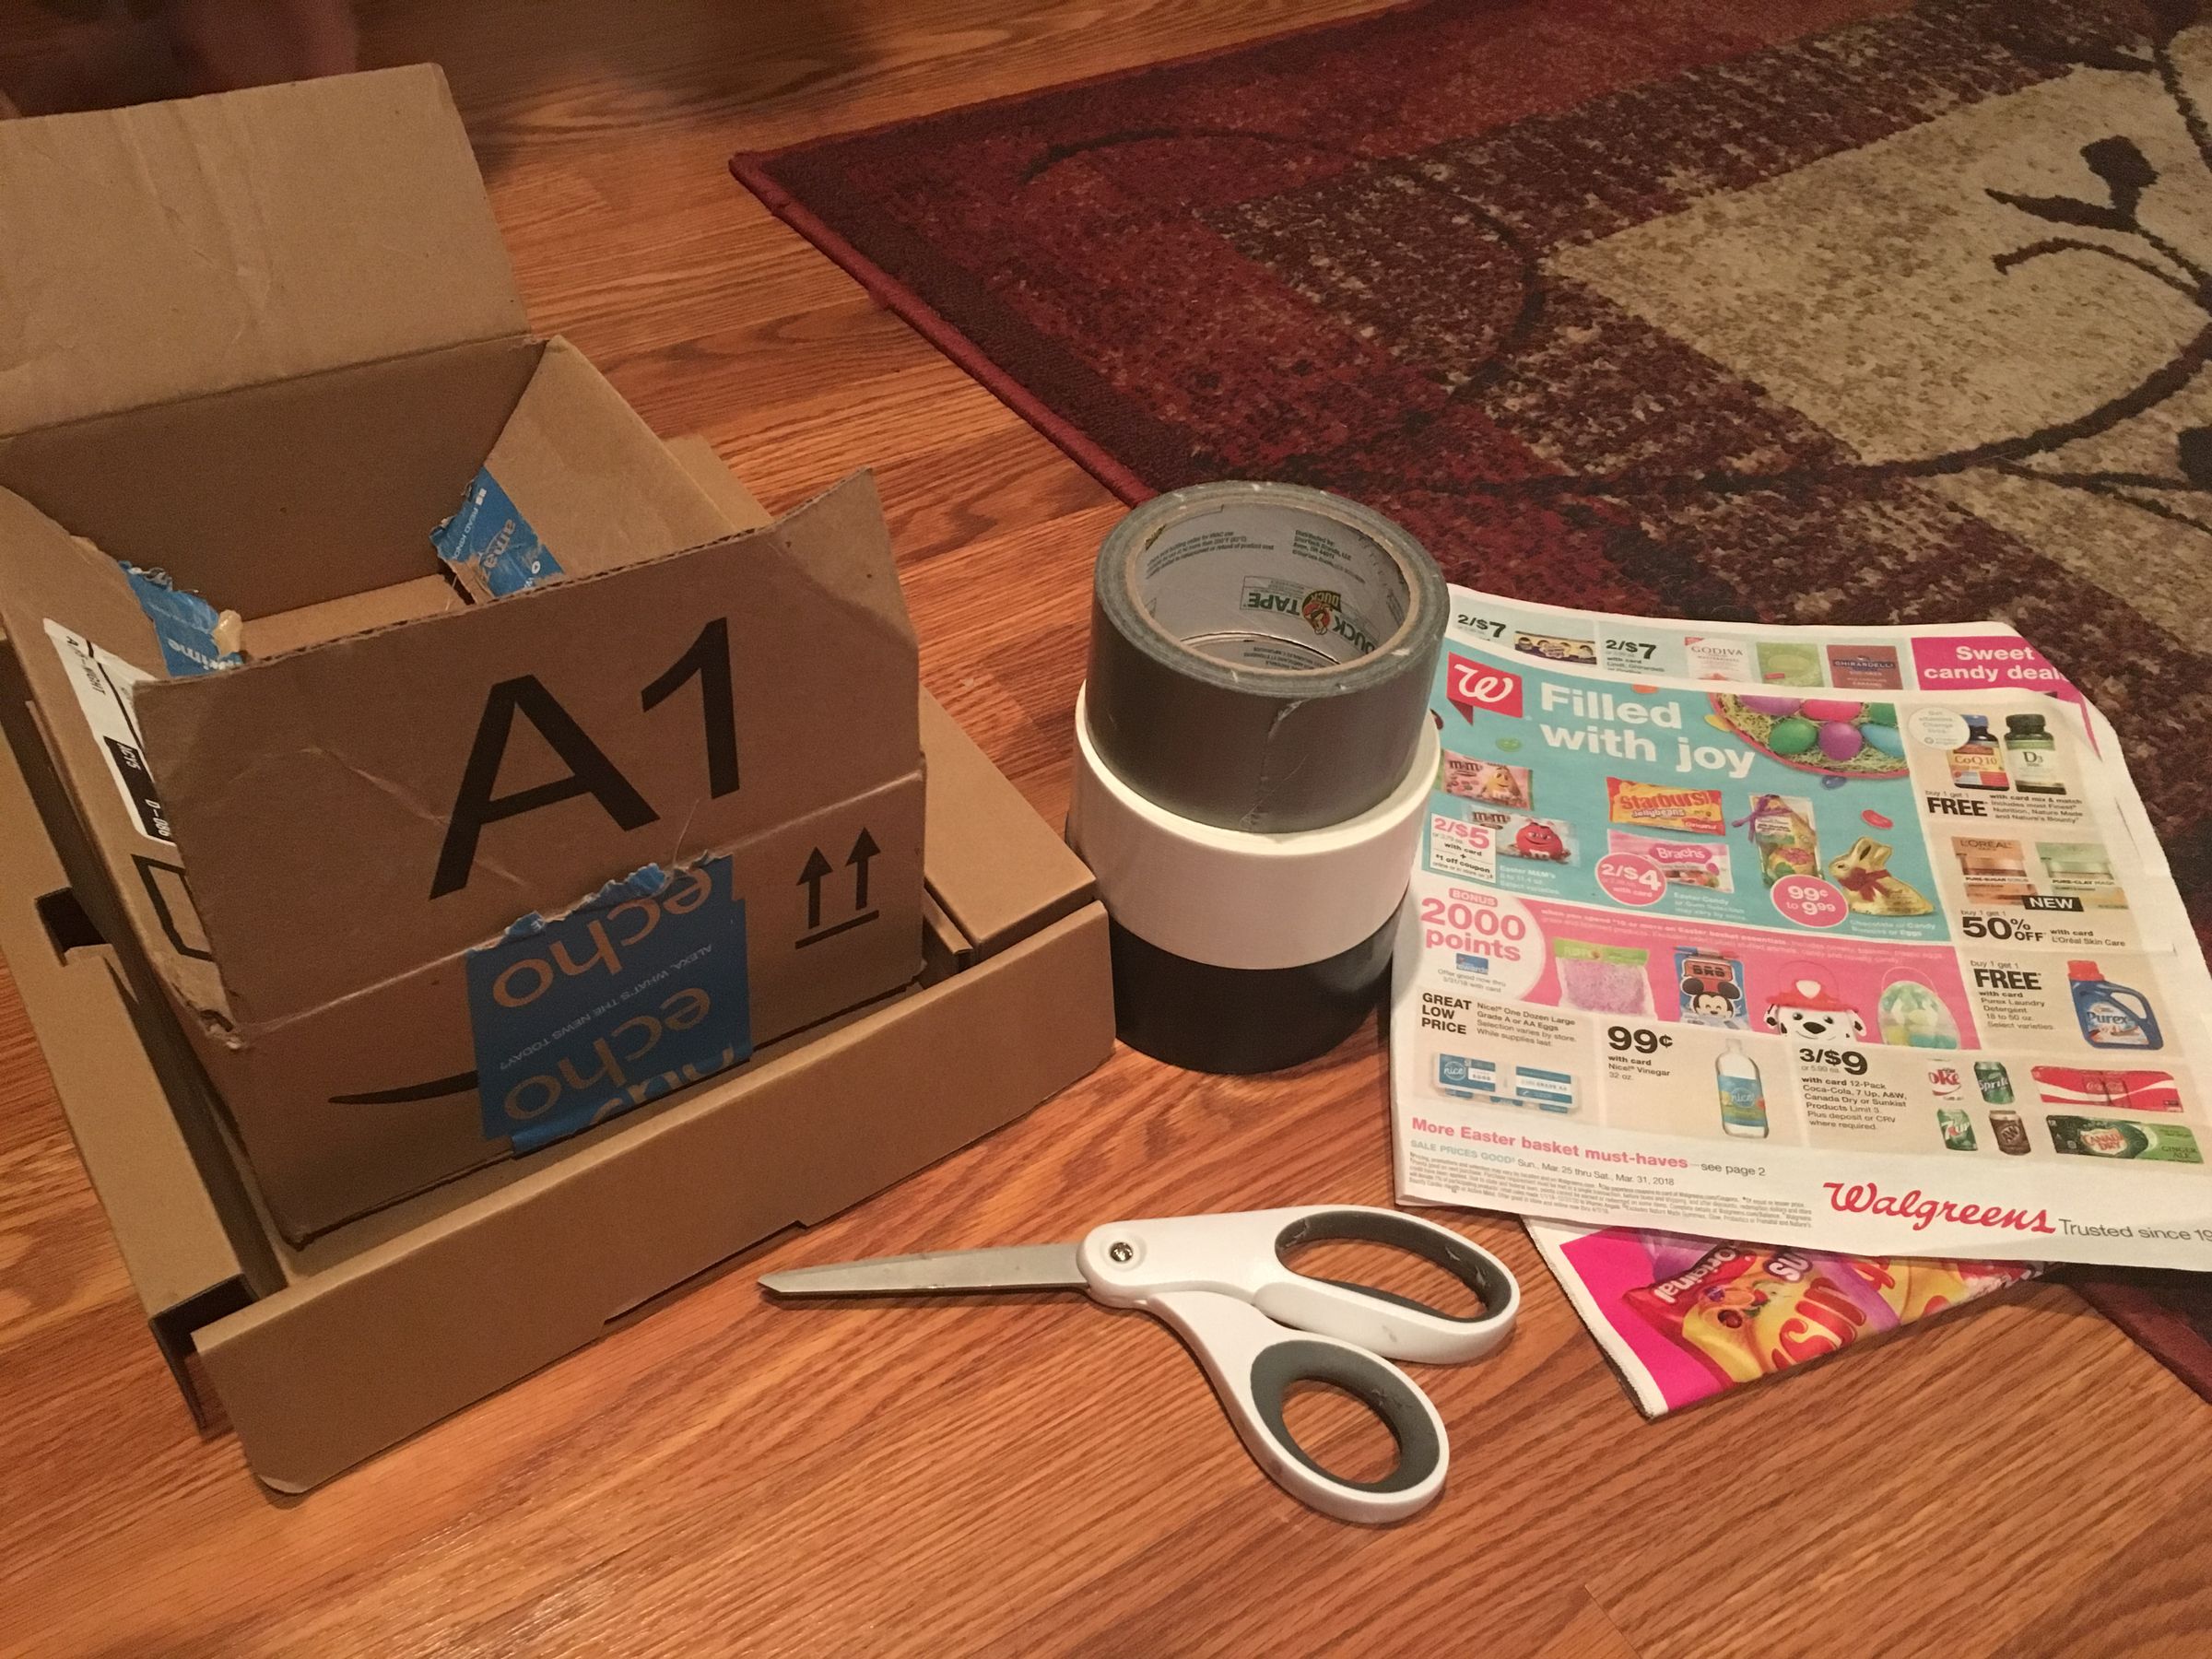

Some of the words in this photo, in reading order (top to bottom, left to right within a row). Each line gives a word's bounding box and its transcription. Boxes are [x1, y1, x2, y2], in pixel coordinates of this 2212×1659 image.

[1248, 592, 1301, 616] TAPE
[1457, 614, 1506, 638] 2/$7
[1606, 640, 1657, 659] 2/$7
[1691, 645, 1743, 656] GODIVA
[1956, 646, 2035, 661] Sweet
[1834, 660, 1894, 669] GHIRARDELLI
[1924, 665, 1998, 682] candy
[1541, 682, 1682, 729] Filled
[429, 617, 739, 900] A1
[1540, 724, 1657, 762] with
[1676, 736, 1756, 779] joy
[1927, 797, 1988, 818] FREE
[1434, 818, 1489, 850] 2/$5
[1460, 861, 1490, 873] coupon
[1602, 864, 1662, 890] 2/$4
[1453, 890, 1496, 907] BONUS
[1788, 886, 1829, 901] 99¢
[2030, 898, 2074, 909] NEW
[1420, 897, 1526, 941] 2000
[492, 867, 712, 1007] echo
[1962, 916, 2031, 940] 50%
[2014, 931, 2043, 942] OFF
[1426, 928, 1521, 961] points
[1970, 959, 1987, 969] buy
[1997, 961, 2013, 970] get
[620, 970, 669, 1000] WHAT'S
[1973, 969, 2041, 990] FREE
[598, 996, 620, 1017] THE
[1422, 993, 1472, 1010] GREAT
[1983, 1006, 2028, 1014] Detergent
[2009, 999, 2045, 1007] Laundry
[1422, 1005, 1454, 1019] LOW
[1477, 1011, 1503, 1021] Grade
[1537, 1022, 1559, 1032] Eggs
[1504, 1007, 1521, 1017] One
[1524, 1010, 1549, 1021] Dozen
[1551, 1016, 1575, 1026] Large
[2087, 1012, 2128, 1025] Purex
[552, 1013, 591, 1041] NEWS
[1421, 1018, 1466, 1034] PRICE
[1477, 1019, 1515, 1031] Selection
[1516, 1026, 1539, 1035] varies
[1541, 1030, 1552, 1039] by
[1554, 1032, 1576, 1042] store.
[1477, 1028, 1500, 1038] While
[1501, 1032, 1535, 1045] supplies
[1606, 1026, 1673, 1053] 99¢
[500, 1037, 551, 1071] TODAY?
[504, 987, 711, 1121] echo
[1607, 1054, 1628, 1064] with
[1630, 1056, 1652, 1065] card
[1799, 1048, 1868, 1076] 3/$9
[1637, 1066, 1670, 1077] Vinegar
[1801, 1077, 1823, 1085] with
[1825, 1078, 1847, 1087] card
[1850, 1080, 1887, 1089] 12-Pack
[1803, 1085, 1853, 1097] Coca-Cola,
[1979, 1077, 2008, 1092] Sprite
[1805, 1093, 1841, 1102] Canada
[1842, 1096, 1859, 1106] Dry
[1872, 1099, 1907, 1107] Sunkist
[1806, 1101, 1848, 1112] Products
[1807, 1111, 1828, 1119] Plus
[1829, 1112, 1862, 1123] deposit
[1809, 1119, 1832, 1127] where
[1834, 1121, 1877, 1131] required.
[1412, 1117, 1454, 1136] More
[1461, 1126, 1516, 1147] Easter
[1522, 1135, 1580, 1157] basket
[1584, 1148, 1688, 1169] must-haves
[1700, 1162, 1722, 1172] see
[1725, 1164, 1756, 1177] page
[1758, 1167, 1766, 1176] 2
[1411, 1139, 1437, 1151] SALE
[1440, 1145, 1478, 1159] PRICES
[1542, 1163, 1559, 1171] Mar.
[1562, 1166, 1572, 1174] 25
[1575, 1168, 1592, 1177] thru
[1637, 1176, 1651, 1184] 31,
[1653, 1177, 1675, 1185] 2018
[1823, 1182, 2056, 1234] Walgreens
[2058, 1218, 2133, 1238] Trusted
[2138, 1228, 2191, 1241] since
